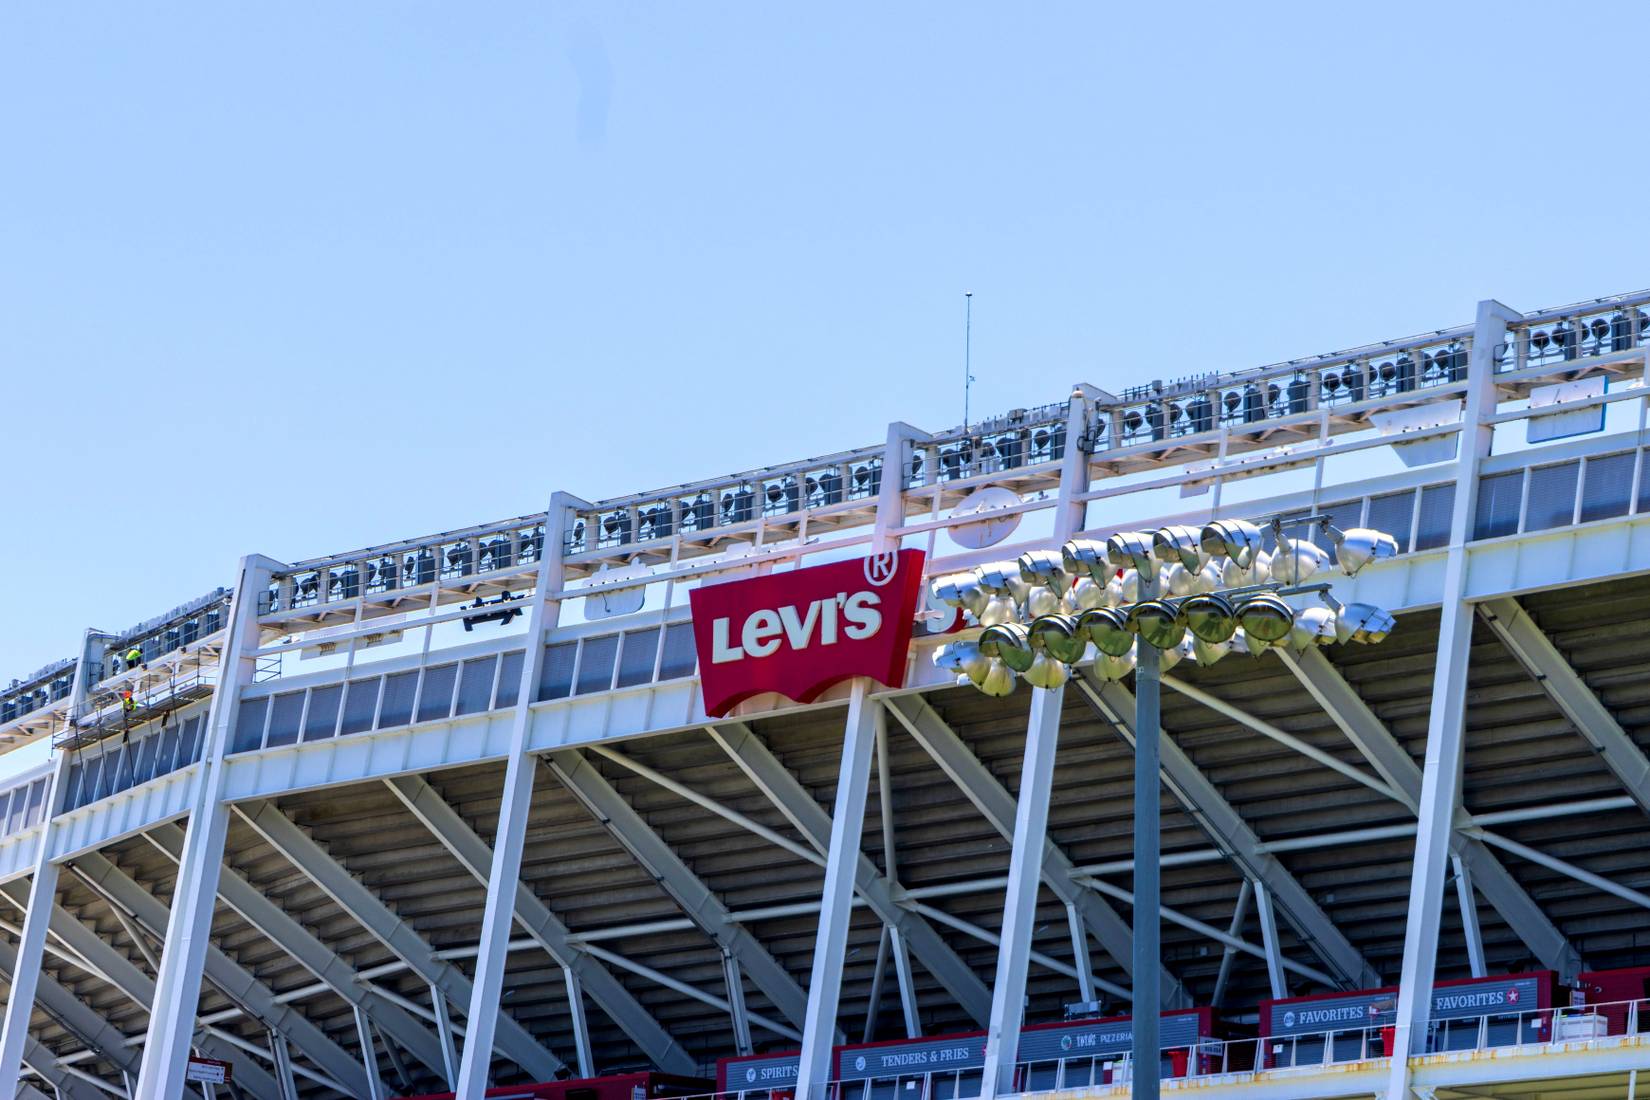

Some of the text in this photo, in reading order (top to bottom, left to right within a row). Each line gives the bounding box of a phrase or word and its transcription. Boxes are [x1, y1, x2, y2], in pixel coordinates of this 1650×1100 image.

[1436, 992, 1504, 1010] FAVORITES
[1299, 1006, 1364, 1024] FAVORITES
[1100, 1032, 1133, 1043] PIZZERIA
[881, 1047, 969, 1067] TENDERS & FRIES
[760, 1065, 799, 1080] SPIRITS
